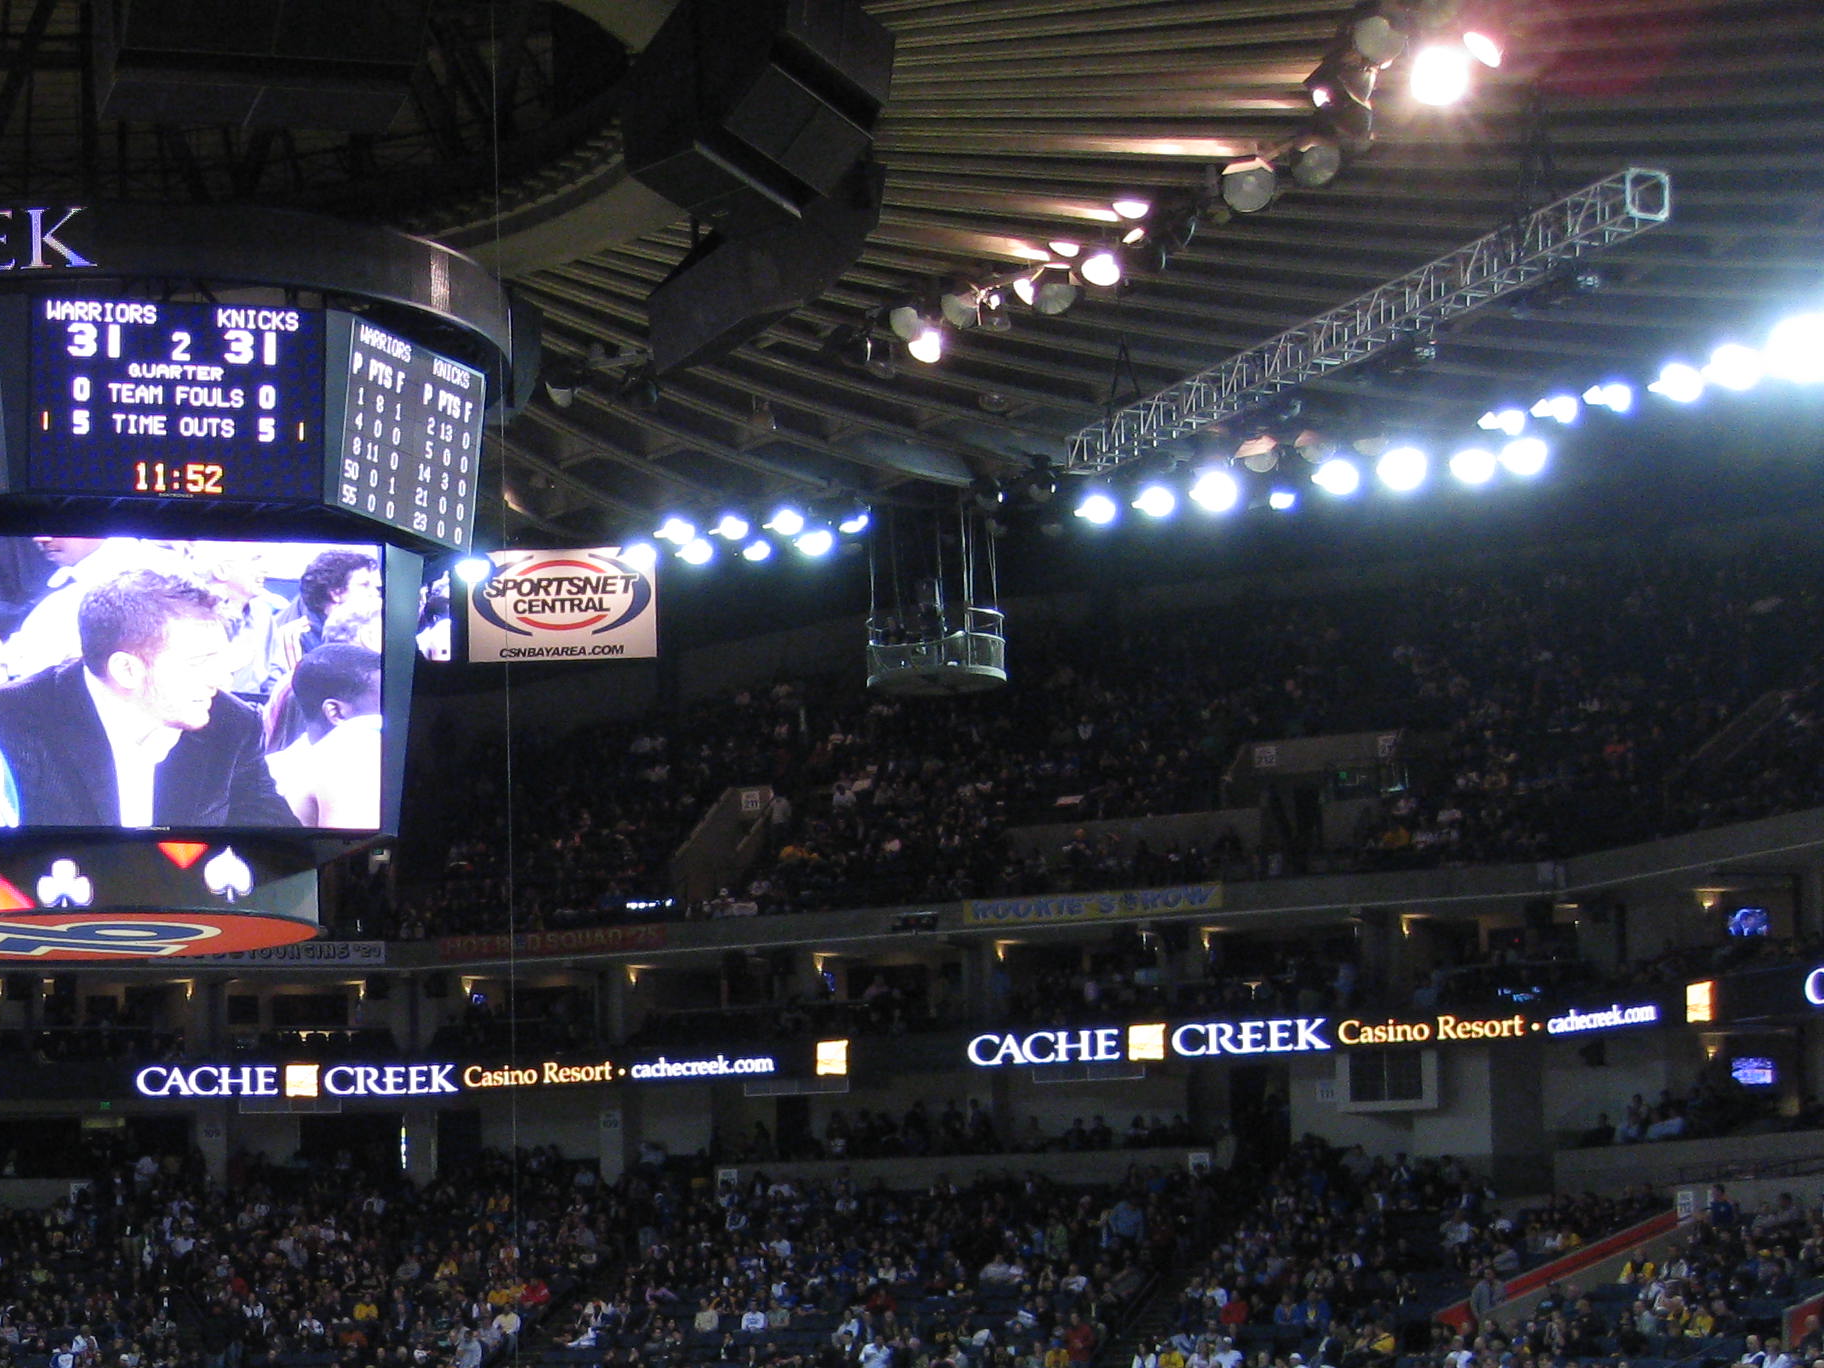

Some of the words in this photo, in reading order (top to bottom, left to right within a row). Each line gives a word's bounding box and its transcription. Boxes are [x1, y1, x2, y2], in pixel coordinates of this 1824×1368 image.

[46, 300, 157, 325] WARRIORS
[217, 309, 299, 331] KNICKS
[67, 322, 121, 358] 31
[171, 331, 191, 361] 2
[224, 329, 276, 366] 31
[360, 324, 412, 362] WARRIORS
[433, 358, 470, 389] KNICKS
[128, 363, 224, 381] QUARTER
[353, 352, 363, 375] P
[369, 358, 393, 389] PTS
[396, 371, 405, 394] F
[423, 383, 433, 405] P
[438, 390, 461, 419] PTS
[464, 401, 472, 423] F
[73, 377, 90, 401] 0
[108, 383, 163, 405] TEAM
[176, 386, 244, 408] FOULS
[259, 385, 276, 409] 0
[73, 410, 90, 435] 5
[112, 414, 168, 436] TIME
[179, 417, 235, 438] OUTS
[258, 418, 275, 442] 5
[358, 387, 364, 406] 1
[376, 394, 384, 413] 8
[395, 403, 401, 422] 1
[427, 417, 436, 436] 2
[440, 422, 453, 443] 13
[462, 432, 470, 450] 0
[355, 413, 363, 431] 4
[374, 419, 382, 438] 0
[392, 427, 401, 446] 0
[425, 441, 433, 459] 5
[443, 449, 451, 466] 0
[460, 456, 468, 474] 0
[136, 462, 223, 493] 11:52
[484, 574, 638, 598] SPORTSNET
[513, 598, 611, 615] CENTRAL
[499, 645, 624, 658] CSNBAYAREA.COM
[967, 1028, 1121, 1067] CACHE
[1173, 1017, 1330, 1058] CREEK
[1338, 1020, 1430, 1047] Casino
[1437, 1013, 1524, 1040] Resort
[1547, 1004, 1657, 1035] cachecreek.com
[136, 1065, 278, 1096] CACHE
[324, 1064, 459, 1096] CREEK
[464, 1067, 538, 1089] Casino
[542, 1059, 613, 1085] Resort
[631, 1053, 775, 1079] cachecreek.com
